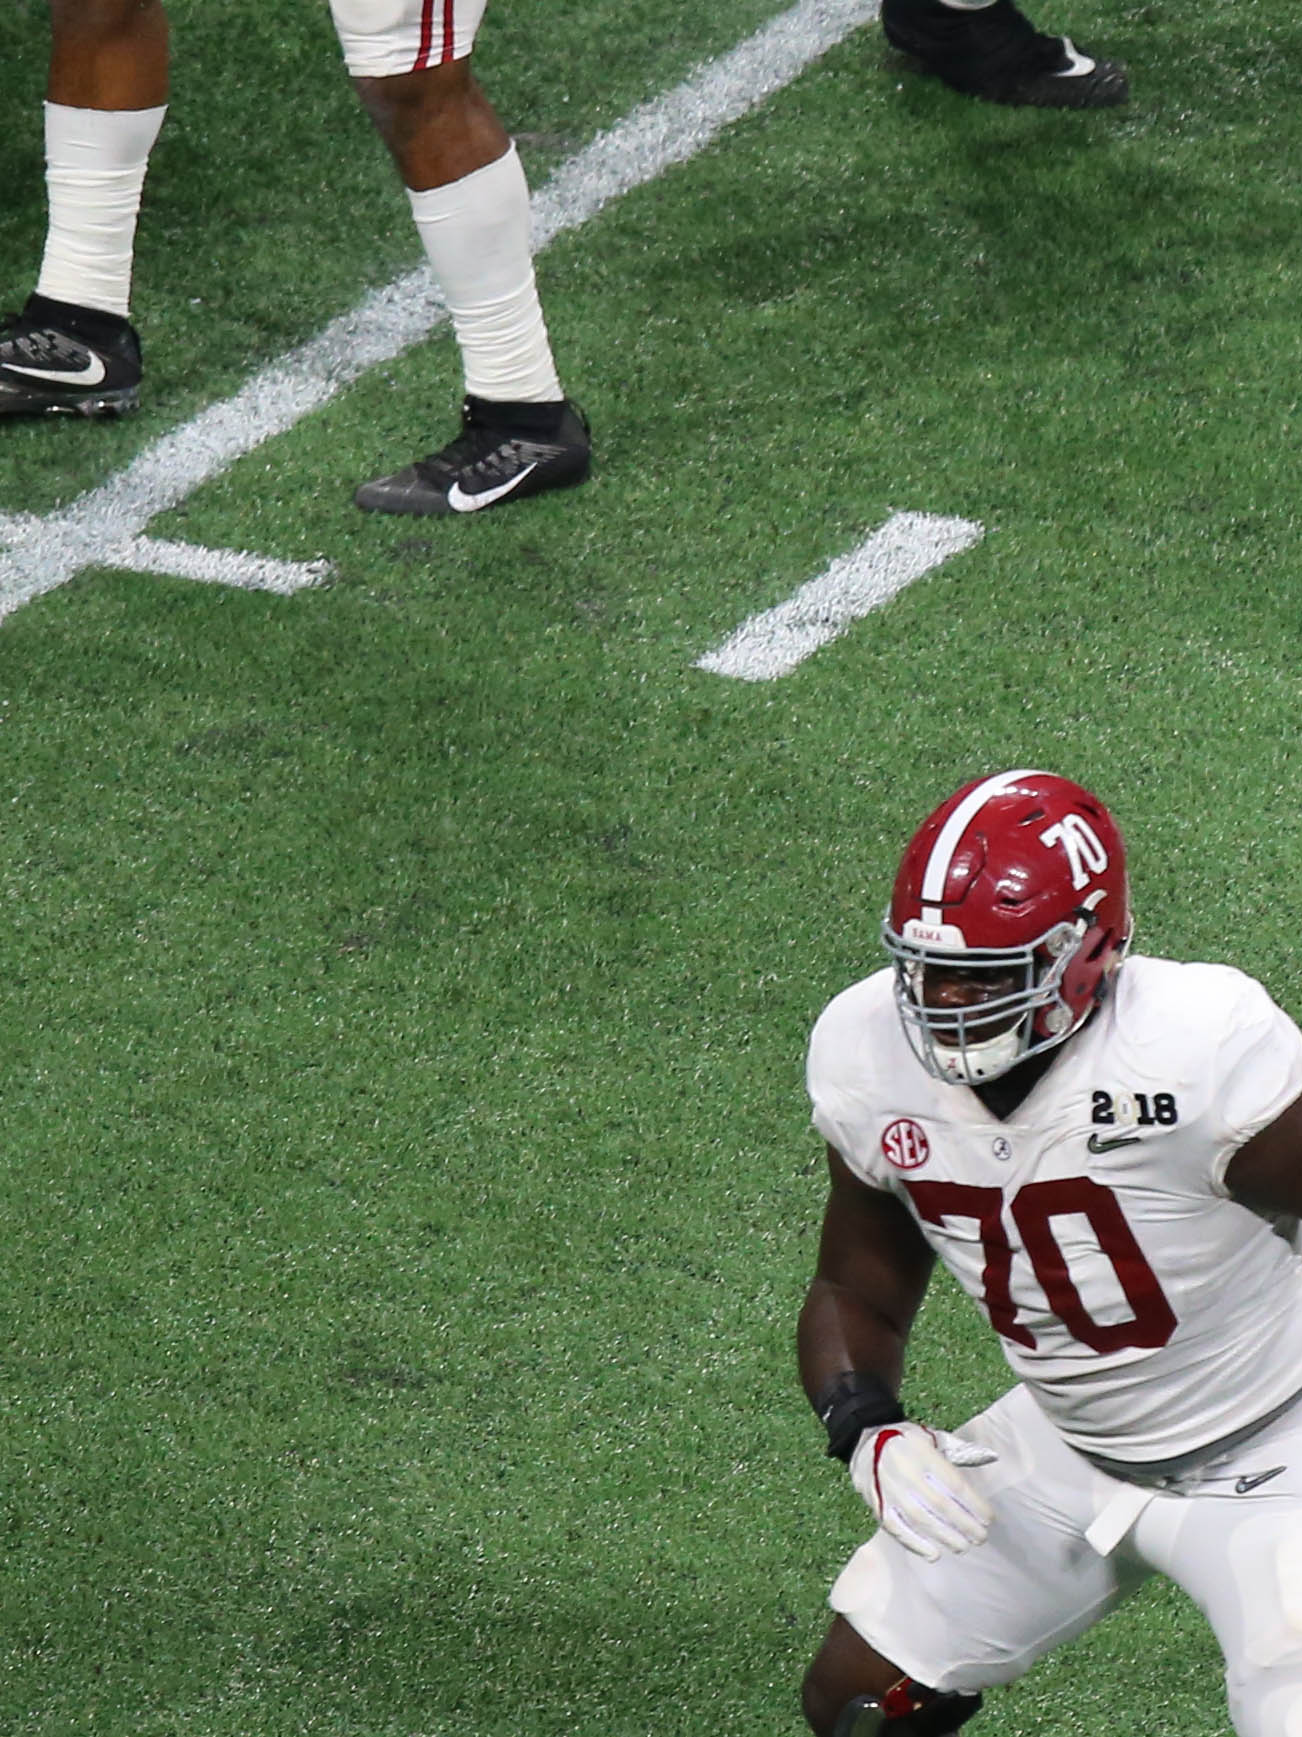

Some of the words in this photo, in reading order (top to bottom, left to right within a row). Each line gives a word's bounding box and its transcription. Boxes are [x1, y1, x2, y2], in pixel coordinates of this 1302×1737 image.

[1039, 813, 1108, 892] 70
[882, 1119, 929, 1168] SEC
[901, 1175, 1178, 1355] 70
